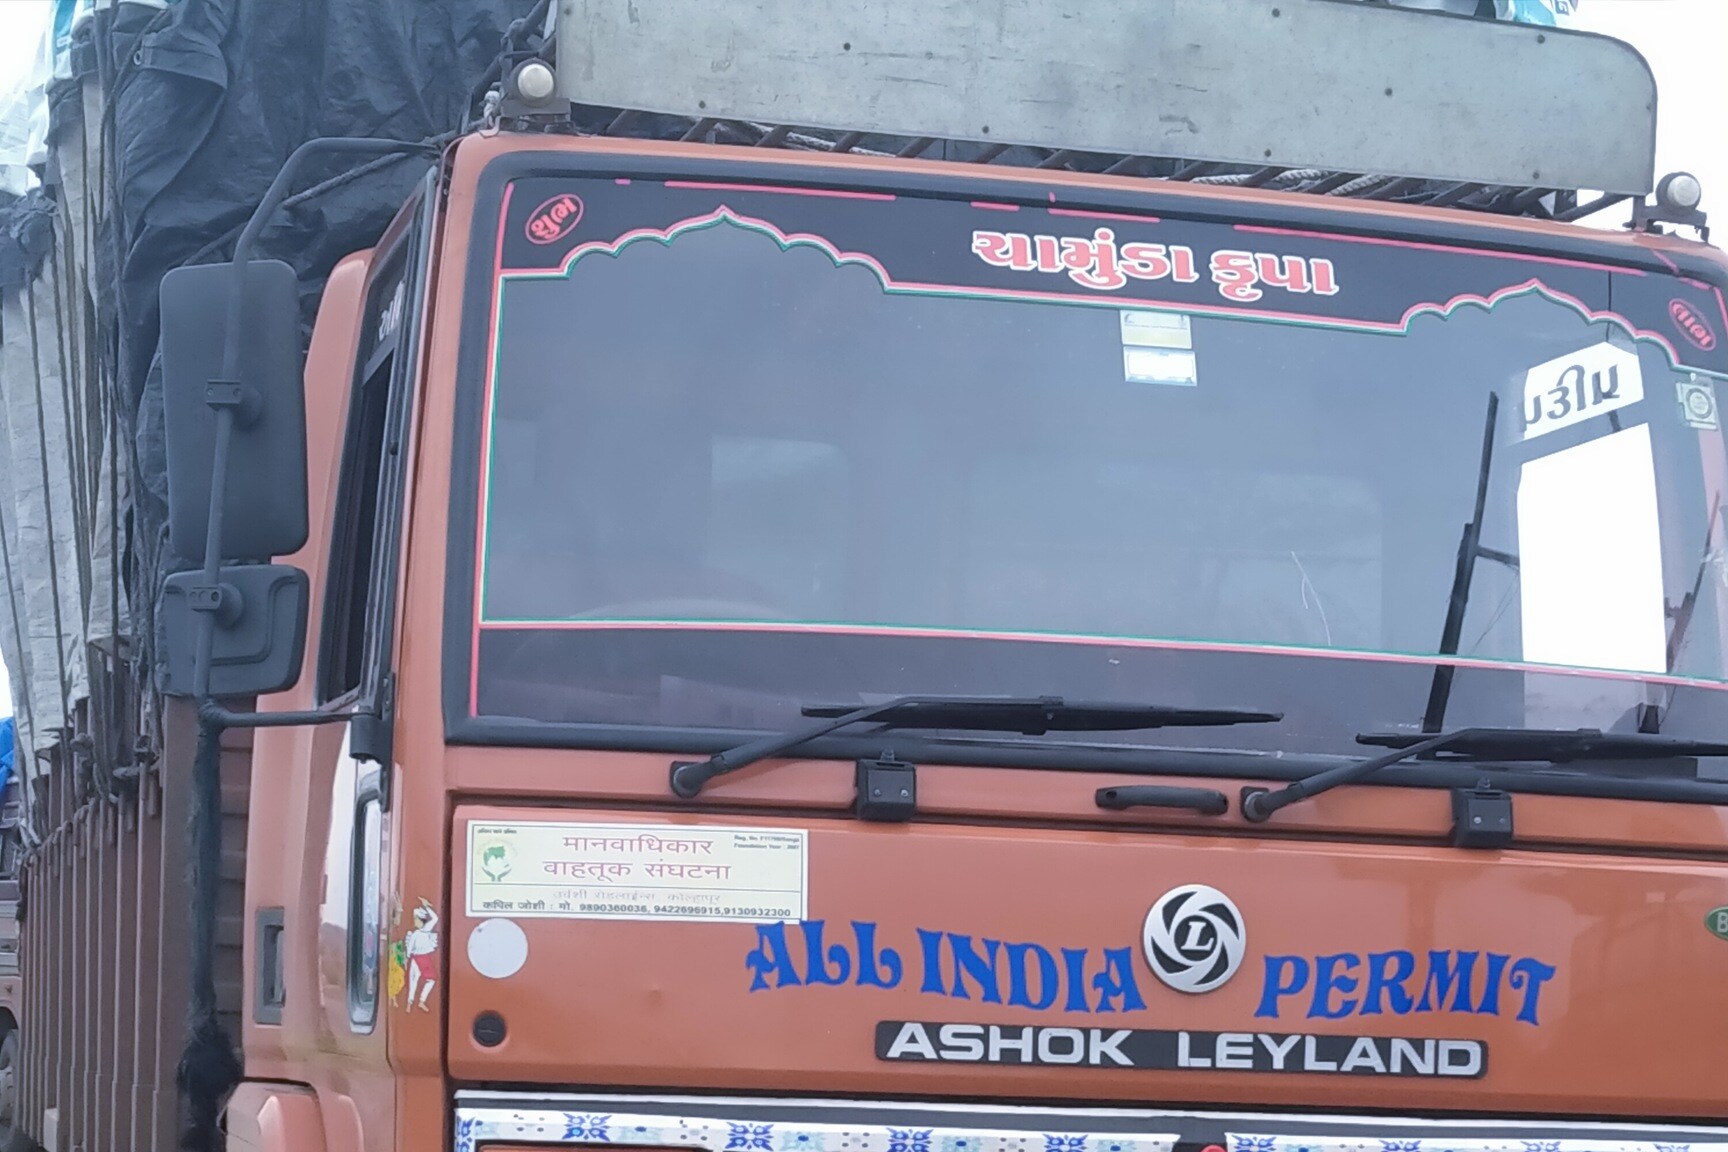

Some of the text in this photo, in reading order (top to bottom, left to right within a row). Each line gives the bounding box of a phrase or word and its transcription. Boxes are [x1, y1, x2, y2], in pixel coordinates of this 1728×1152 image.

[531, 198, 578, 240] શુભ
[972, 228, 1340, 302] ચામુંડા કૃપા
[1672, 303, 1711, 346] લાભ
[562, 834, 714, 855] मानवाधिकार
[543, 858, 732, 882] वाहतूक संघटना
[745, 920, 1556, 1026] ALL INDIA PERMIT
[886, 1022, 1482, 1075] ASHOK LEYLAND
